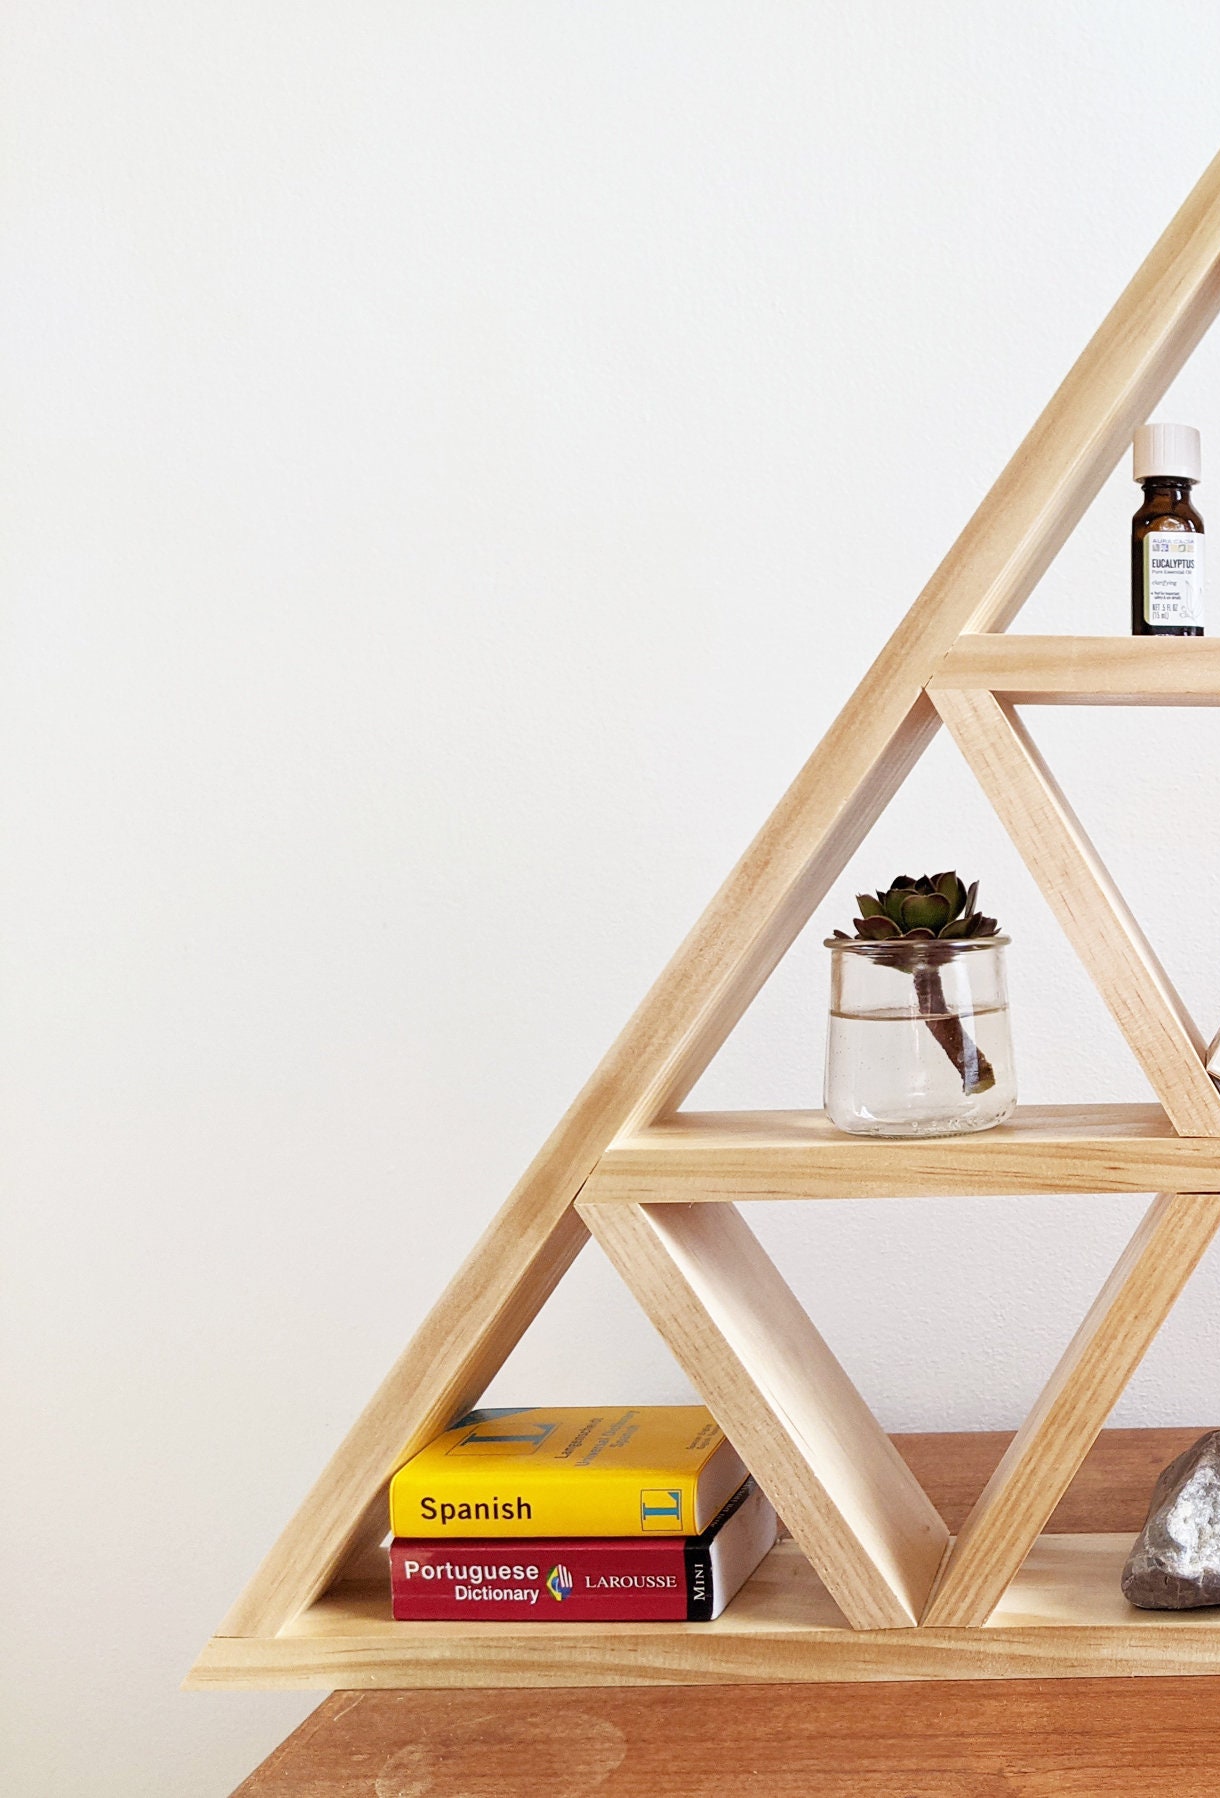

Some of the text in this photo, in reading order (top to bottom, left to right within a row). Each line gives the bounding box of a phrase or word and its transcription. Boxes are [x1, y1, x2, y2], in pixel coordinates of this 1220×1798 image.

[1151, 558, 1195, 569] EUCALYPTUS
[420, 1496, 532, 1525] Spanish
[642, 1491, 680, 1521] L
[404, 1560, 540, 1585] Portuguese
[585, 1575, 678, 1589] LAROUSSE
[454, 1585, 540, 1605] Dictionary
